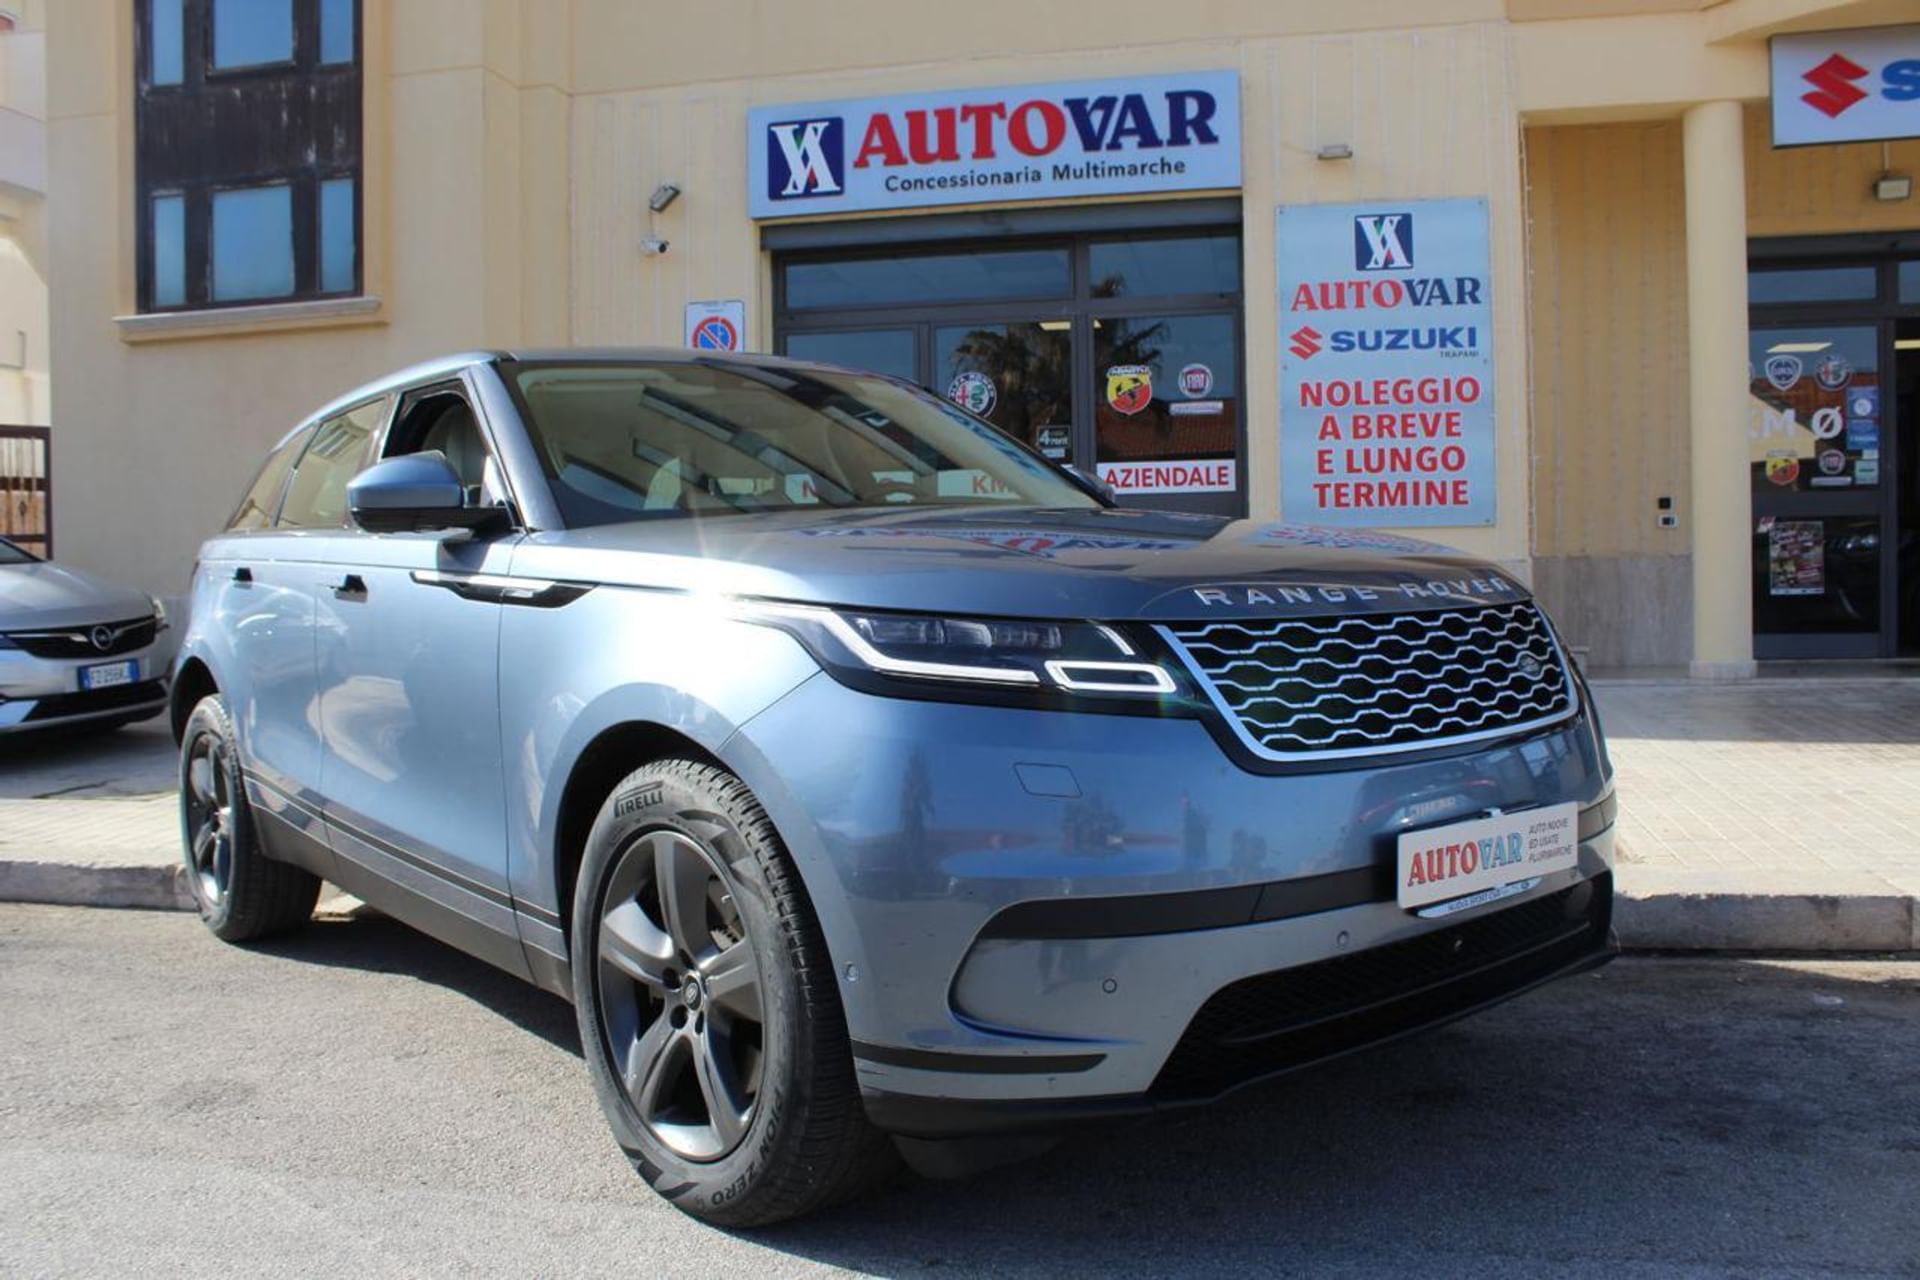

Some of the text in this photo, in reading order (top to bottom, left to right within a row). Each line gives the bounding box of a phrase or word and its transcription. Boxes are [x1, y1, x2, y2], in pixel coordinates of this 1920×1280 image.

[853, 90, 1219, 168] AUTOVAR
[884, 156, 1187, 193] Concessionaria Multimarche
[1290, 277, 1482, 312] AUTOVAR
[1330, 326, 1478, 352] SUZUKI
[1300, 376, 1481, 407] NOLEGGIO
[1318, 412, 1462, 441] A BREVE
[1317, 445, 1466, 475] E LUNGO
[1104, 466, 1230, 488] AZIENDALE
[1313, 480, 1469, 508] TERMINE
[1194, 577, 1512, 606] RANGE ROVER
[1407, 832, 1524, 887] AUTOVAR
